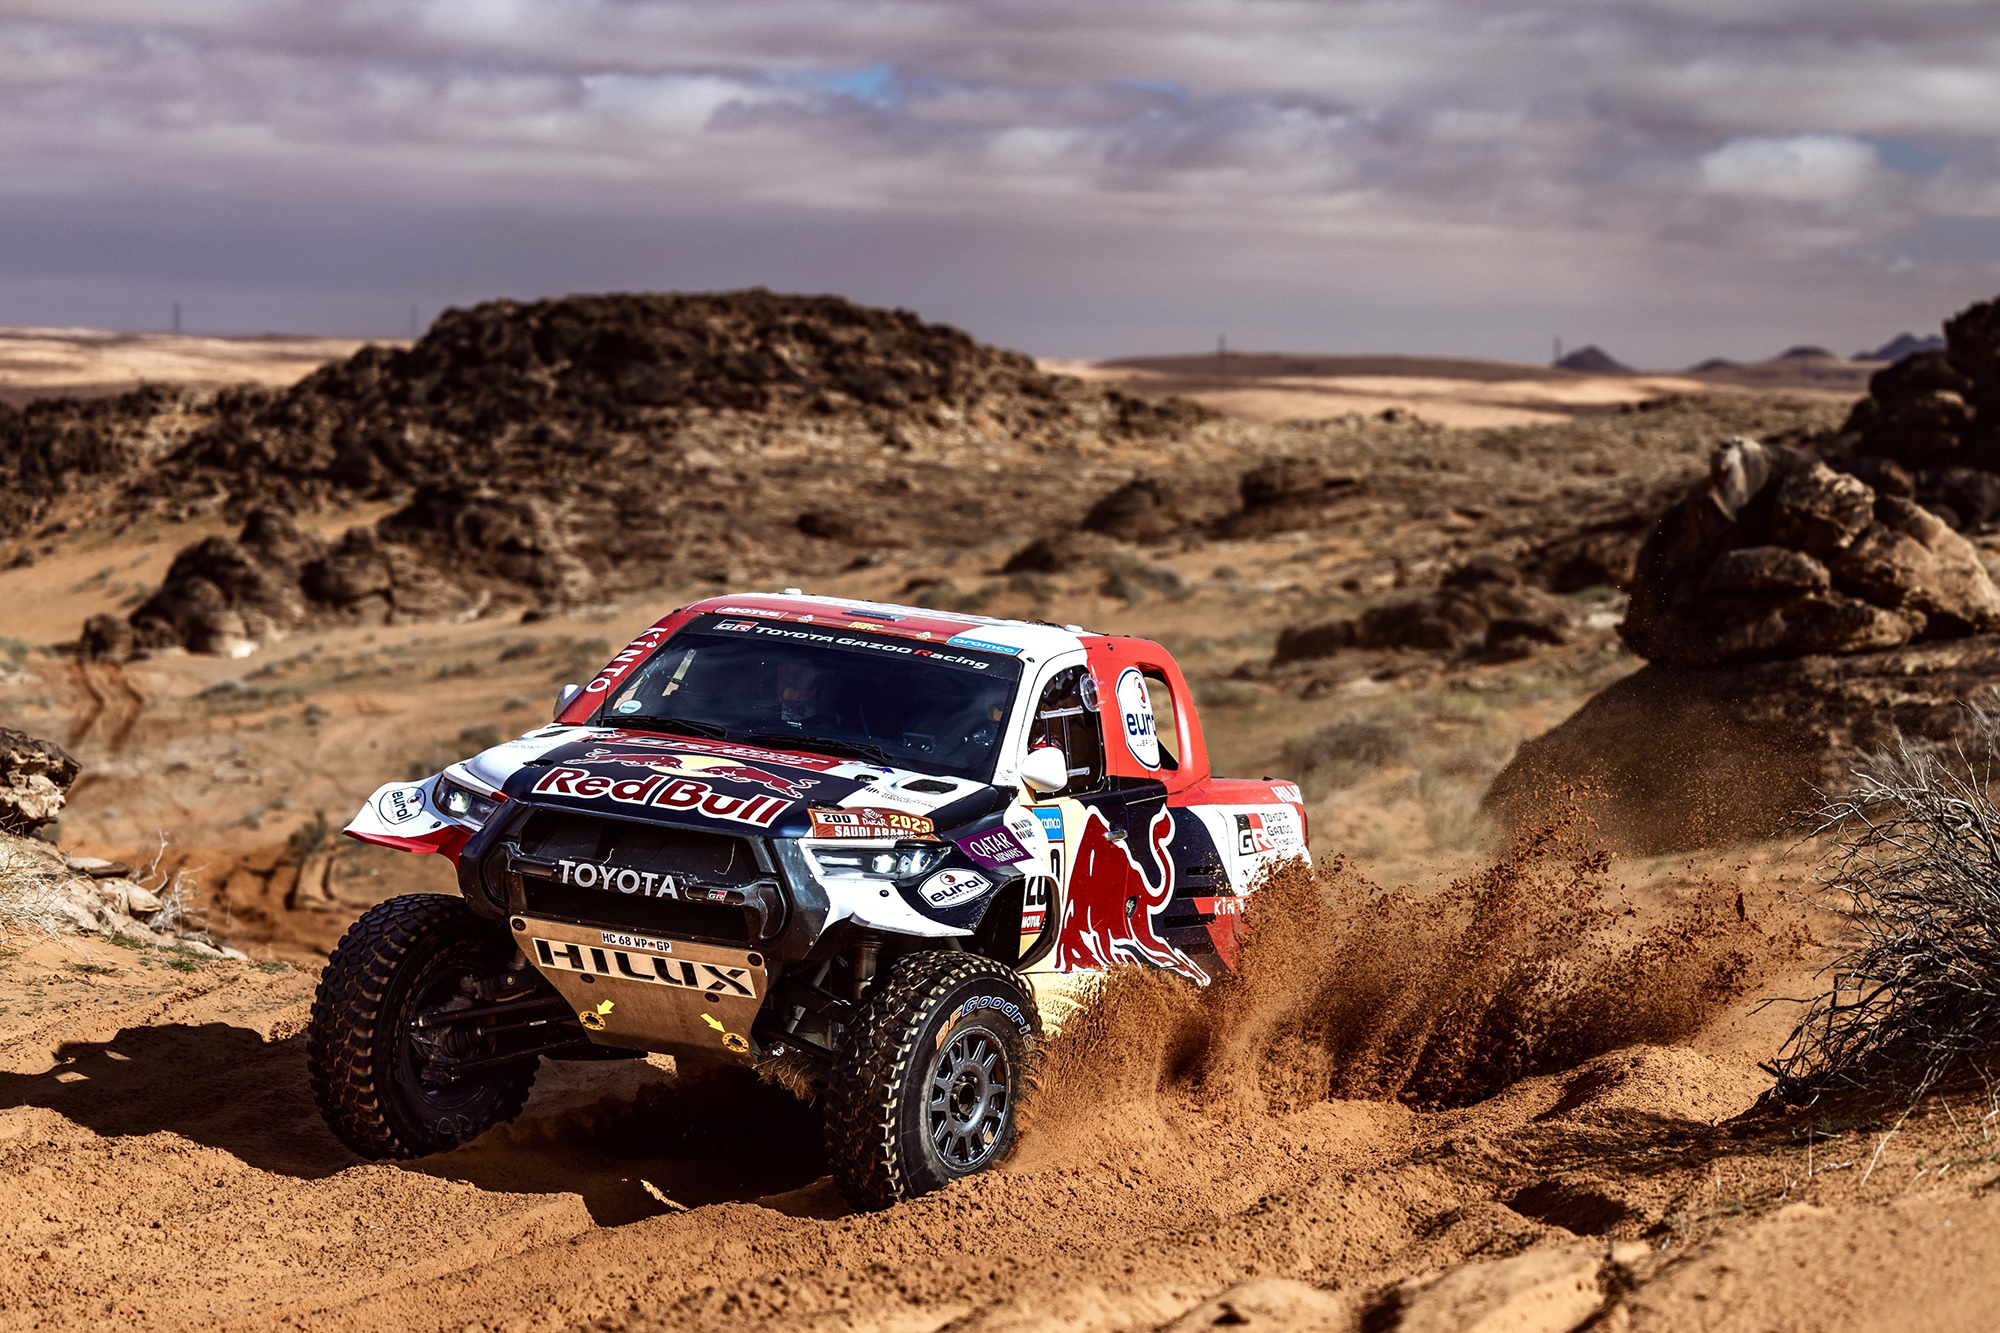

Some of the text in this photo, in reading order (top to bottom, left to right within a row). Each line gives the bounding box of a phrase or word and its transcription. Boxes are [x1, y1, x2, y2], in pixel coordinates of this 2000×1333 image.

[721, 606, 781, 618] MOTUL
[756, 626, 834, 643] TOYOTA
[835, 637, 913, 655] GAZOO
[913, 648, 990, 670] Racing
[953, 637, 1016, 654] aramco
[391, 791, 413, 821] eurol
[533, 767, 794, 828] Red Bull
[822, 813, 852, 824] 200
[861, 814, 930, 834] DAKAR 2023
[1260, 812, 1288, 823] TOYOTA
[834, 825, 871, 838] SAUDI
[1238, 827, 1275, 855] GR
[1266, 825, 1294, 837] GAZOO
[969, 832, 1015, 859] QATAR
[992, 847, 1024, 864] AIRWAYS
[557, 859, 726, 902] TOYOTA GR
[930, 876, 984, 902] eurol
[602, 932, 671, 952] HC 68 WP GP
[535, 939, 753, 997] HILUX
